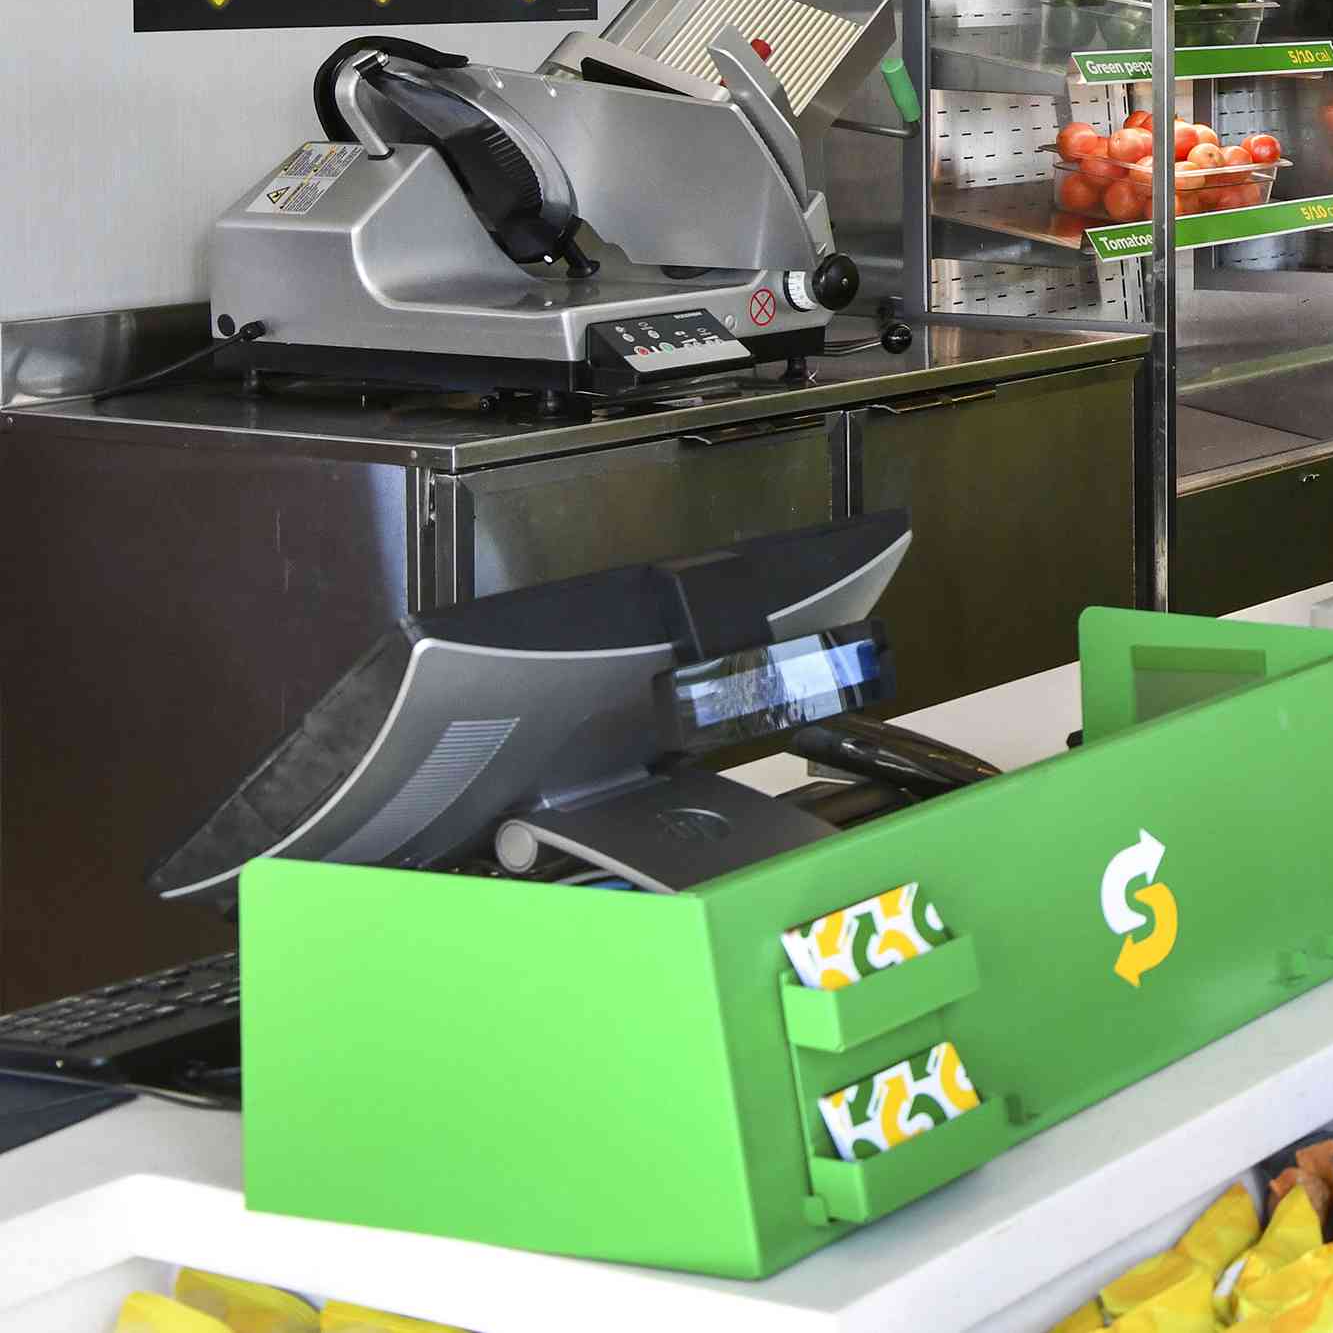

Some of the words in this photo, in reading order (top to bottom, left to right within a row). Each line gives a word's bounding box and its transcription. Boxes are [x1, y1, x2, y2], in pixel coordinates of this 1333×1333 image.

[1288, 49, 1315, 64] 5/10
[1316, 48, 1333, 62] cal
[1086, 57, 1121, 76] Green
[1123, 59, 1153, 80] pepp
[1300, 205, 1327, 220] 5/10
[1099, 230, 1153, 251] Tomatoe
